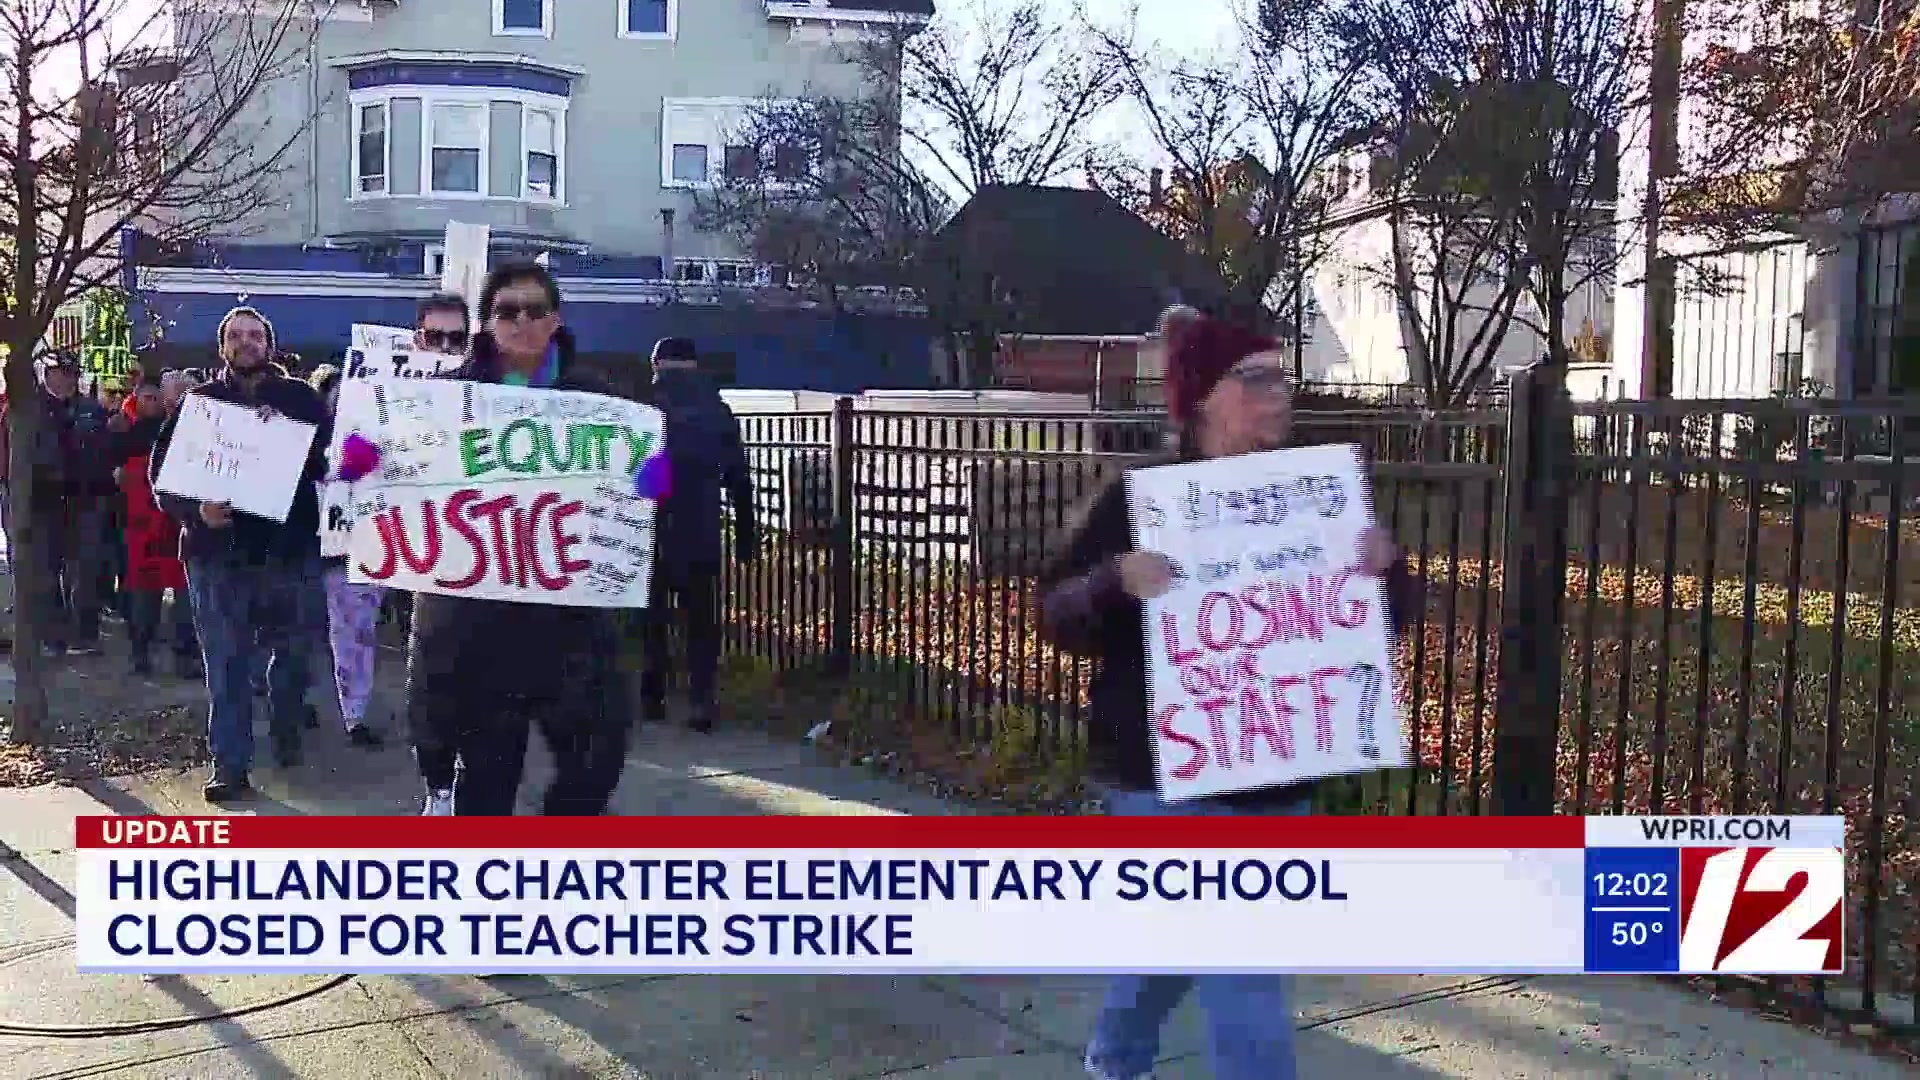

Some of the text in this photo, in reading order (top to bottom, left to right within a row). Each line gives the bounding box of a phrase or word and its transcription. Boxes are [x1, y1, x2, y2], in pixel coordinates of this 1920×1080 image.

[460, 418, 651, 477] EQUITY
[359, 488, 592, 591] JUSTICE
[1160, 565, 1370, 667] LOSING
[1157, 661, 1383, 781] STAFF?
[1180, 653, 1261, 695] OUR
